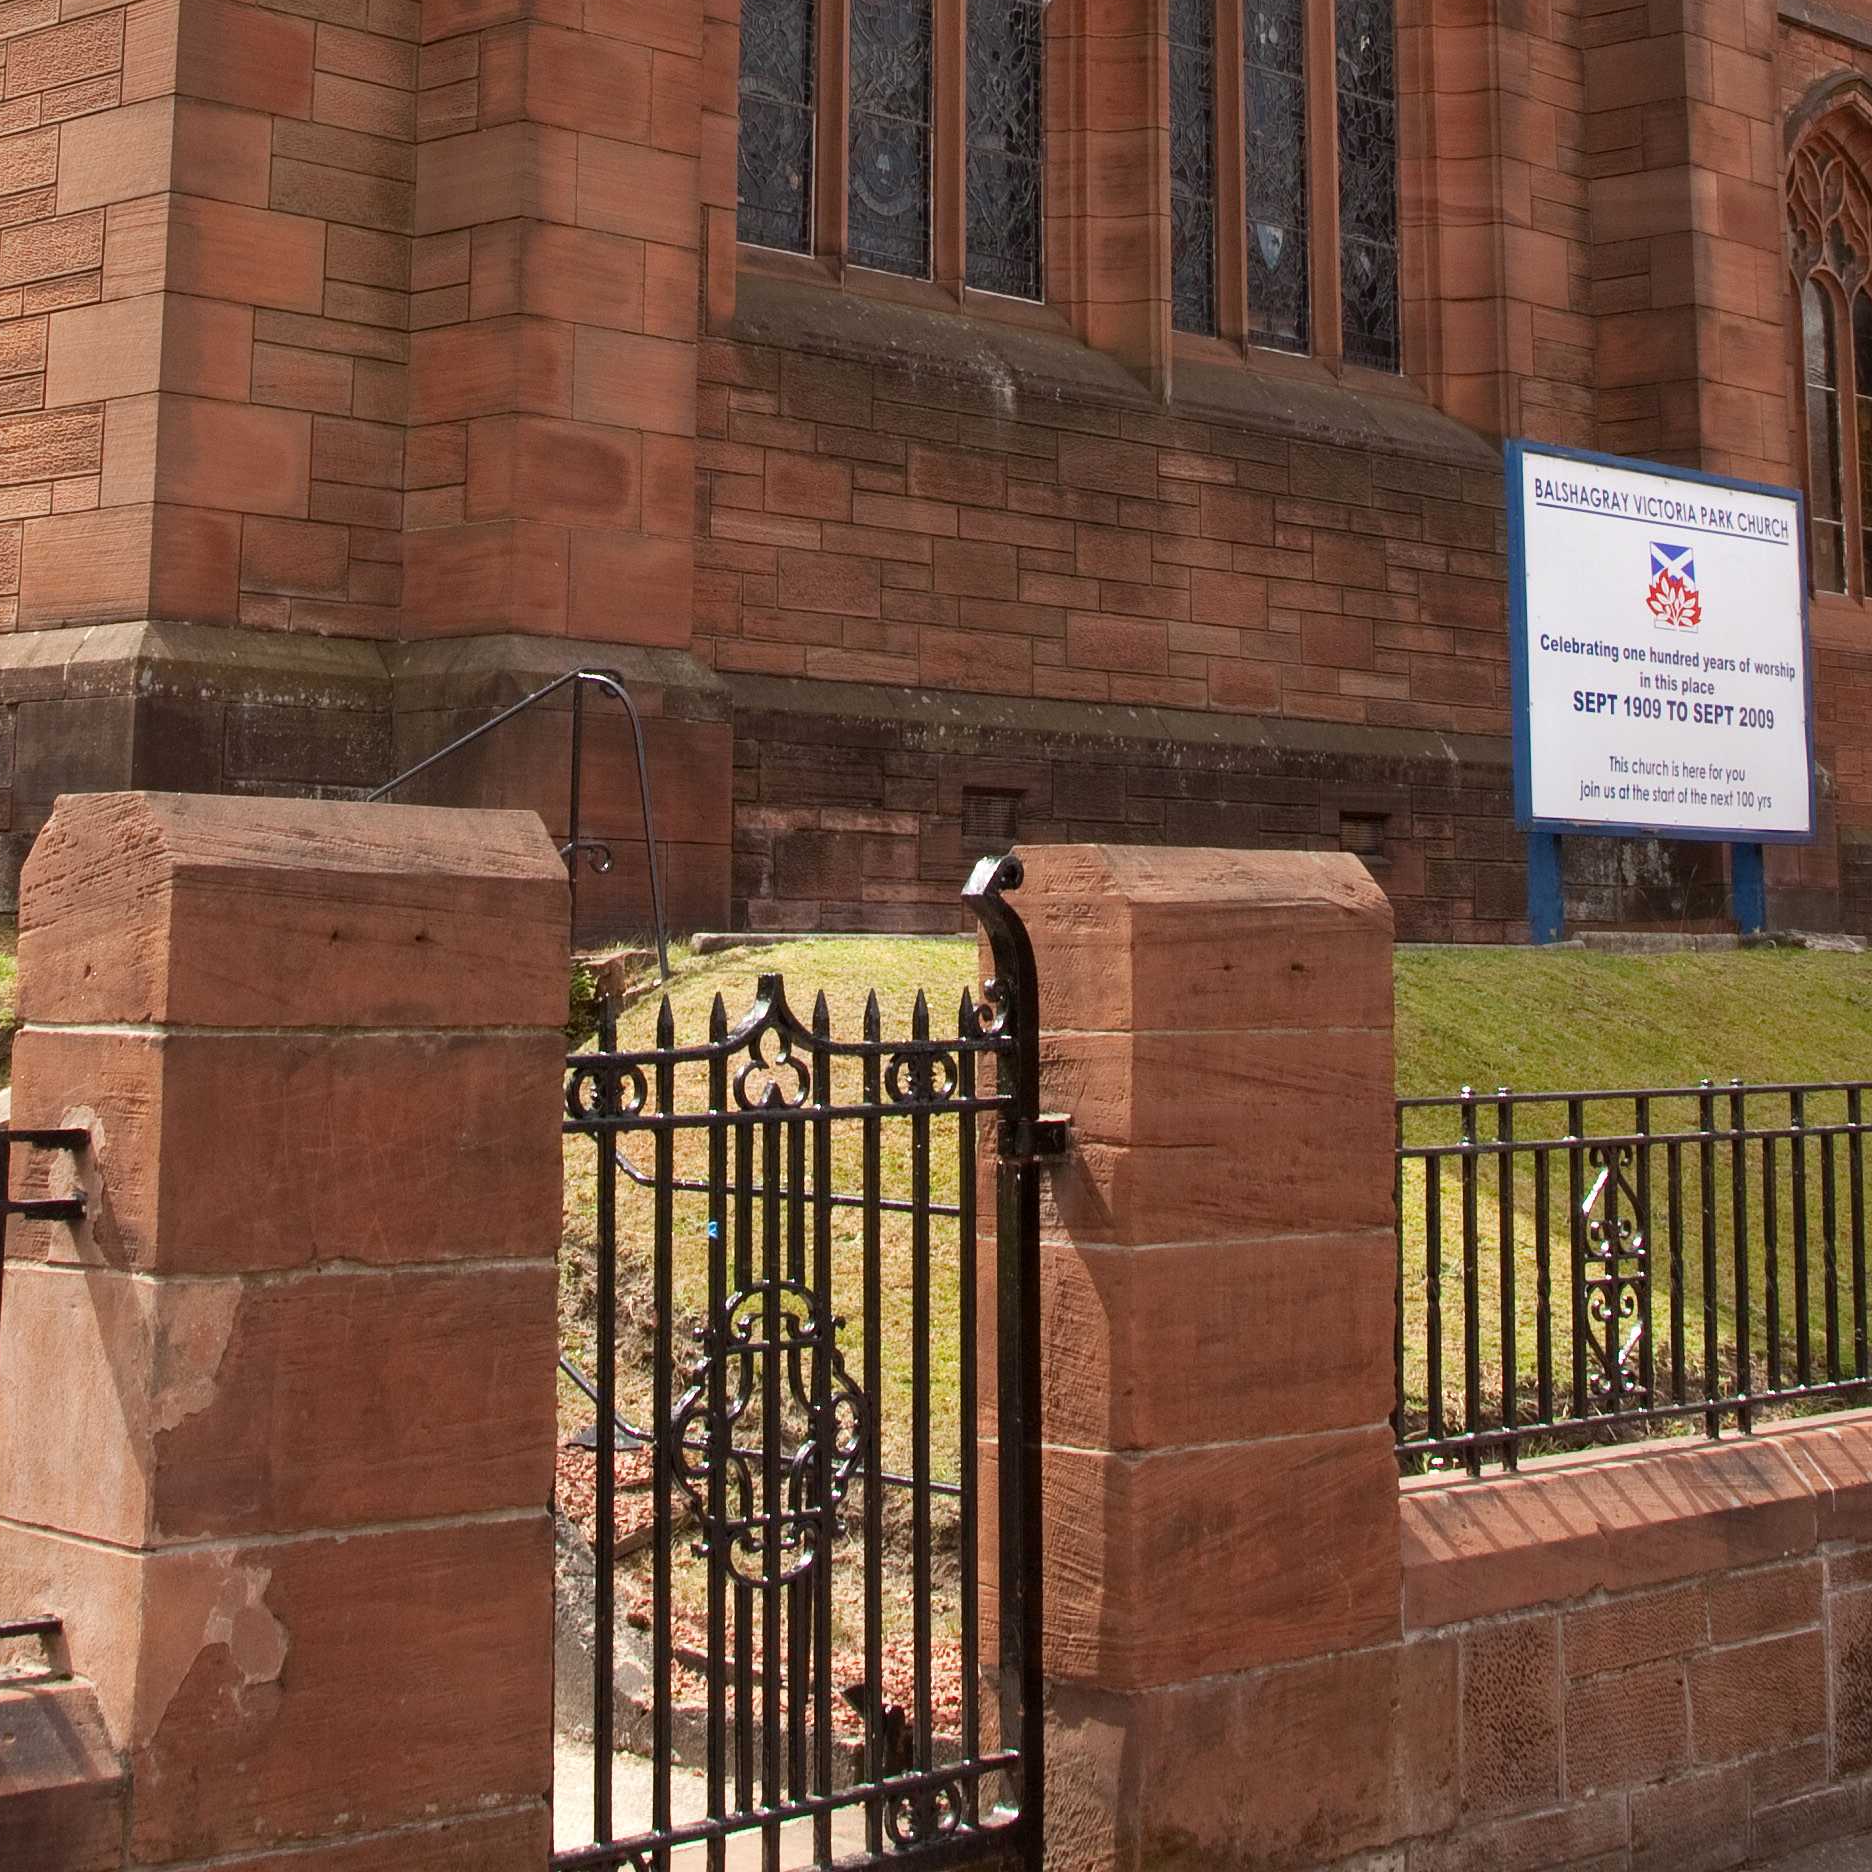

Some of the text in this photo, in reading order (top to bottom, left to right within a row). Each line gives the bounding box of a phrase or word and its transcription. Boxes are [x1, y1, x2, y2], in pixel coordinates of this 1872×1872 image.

[1535, 478, 1789, 538] BALSHAGRAY VICTORIA PARK CHURCH
[1540, 634, 1796, 681] Celebrating one hundred years of worship
[1640, 672, 1715, 695] in this place
[1573, 690, 1774, 729] SEPT 1909 TO SEPT 2009
[1609, 756, 1746, 784] This church is here for you
[1580, 780, 1772, 811] join us at the start of the next 100 yrs
